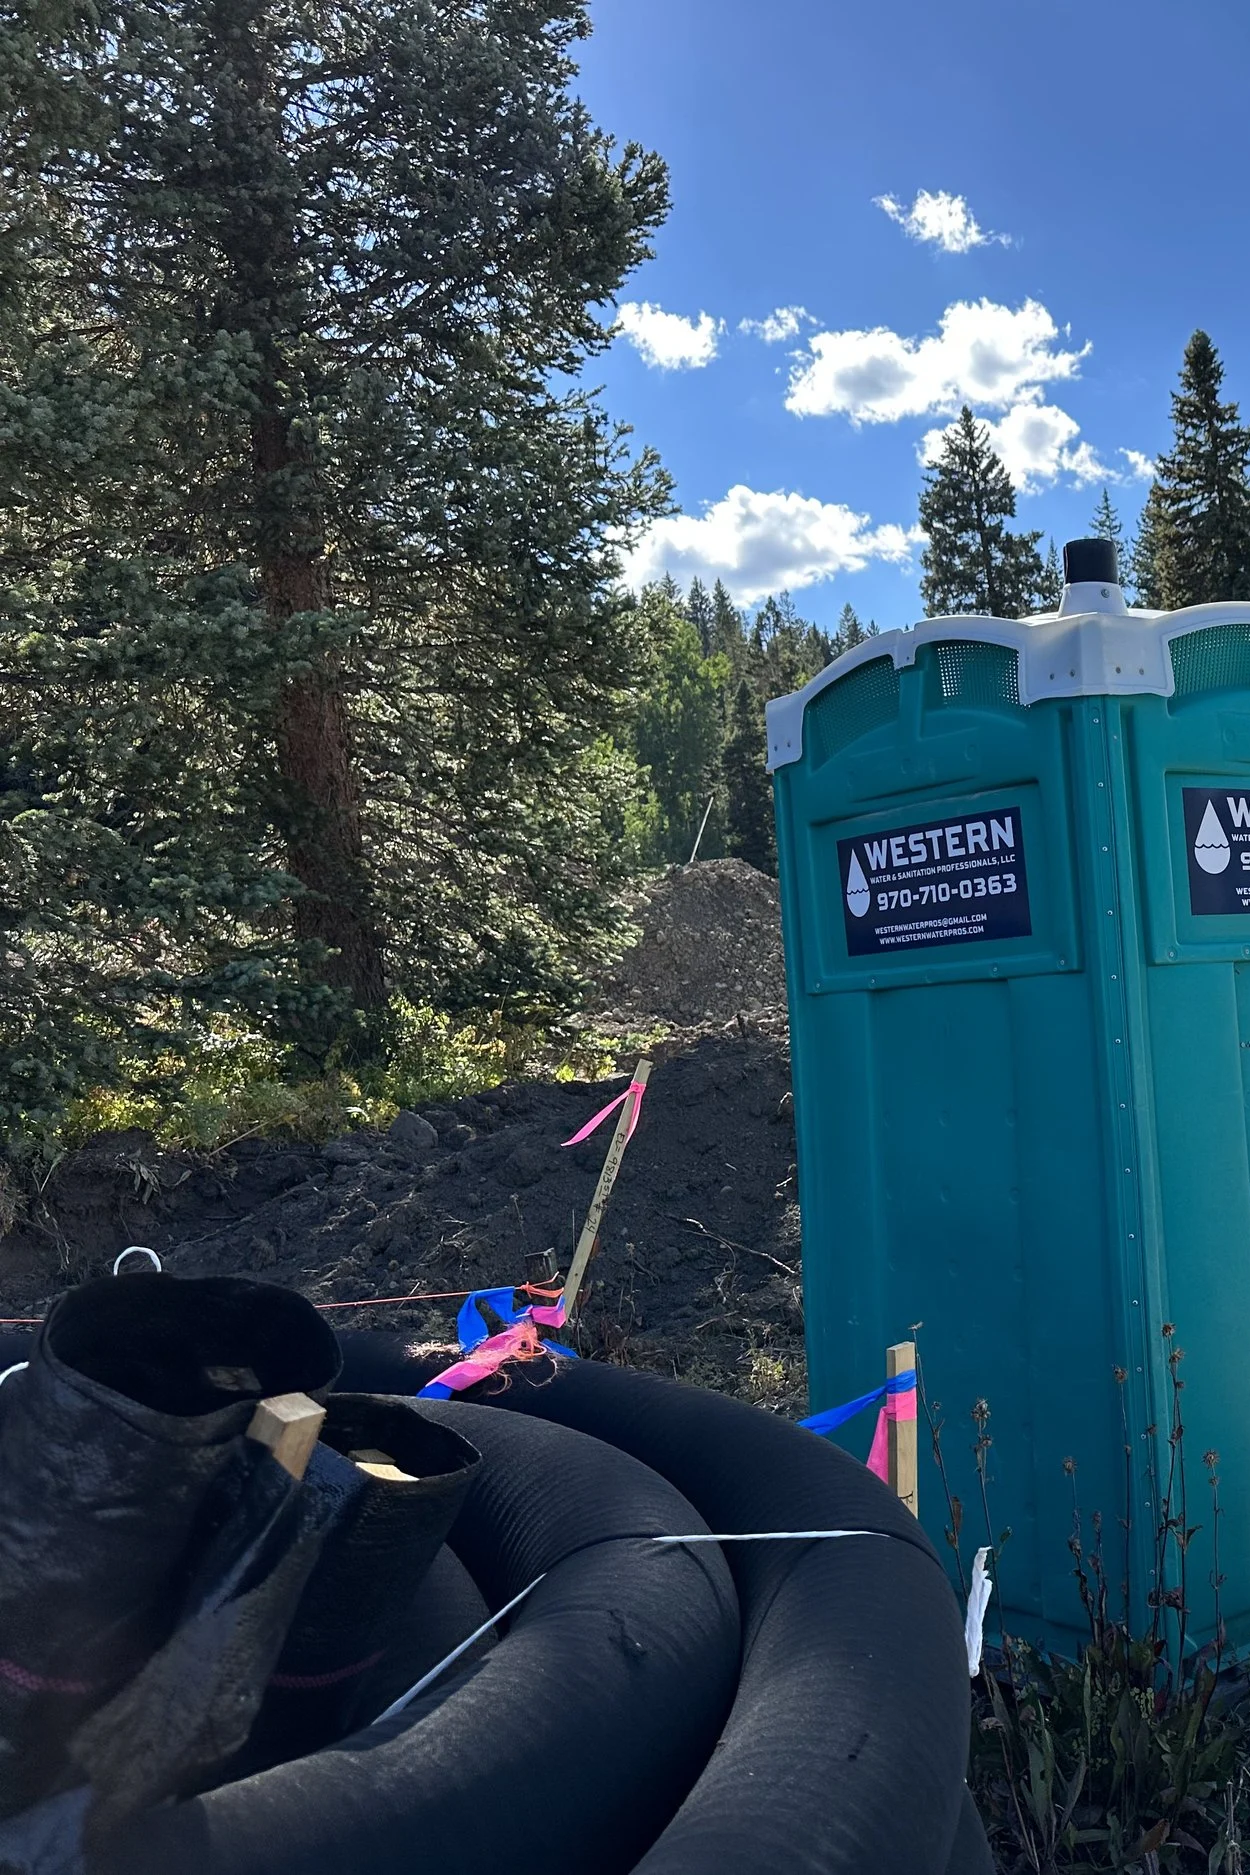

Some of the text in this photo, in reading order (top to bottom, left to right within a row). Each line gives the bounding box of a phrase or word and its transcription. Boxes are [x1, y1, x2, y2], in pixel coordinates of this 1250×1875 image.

[864, 816, 1014, 871] WESTERN
[870, 874, 891, 885] WATER
[898, 866, 936, 880] SANITATION
[937, 857, 999, 874] PROFESSIONALS,
[1001, 854, 1015, 863] LLC
[877, 873, 1017, 911] 970-710-0363
[875, 914, 987, 935] WESTERNWATERPROS@GMAIL.COM
[879, 926, 984, 945] WWW.WESTERNWATERPROS.COM
